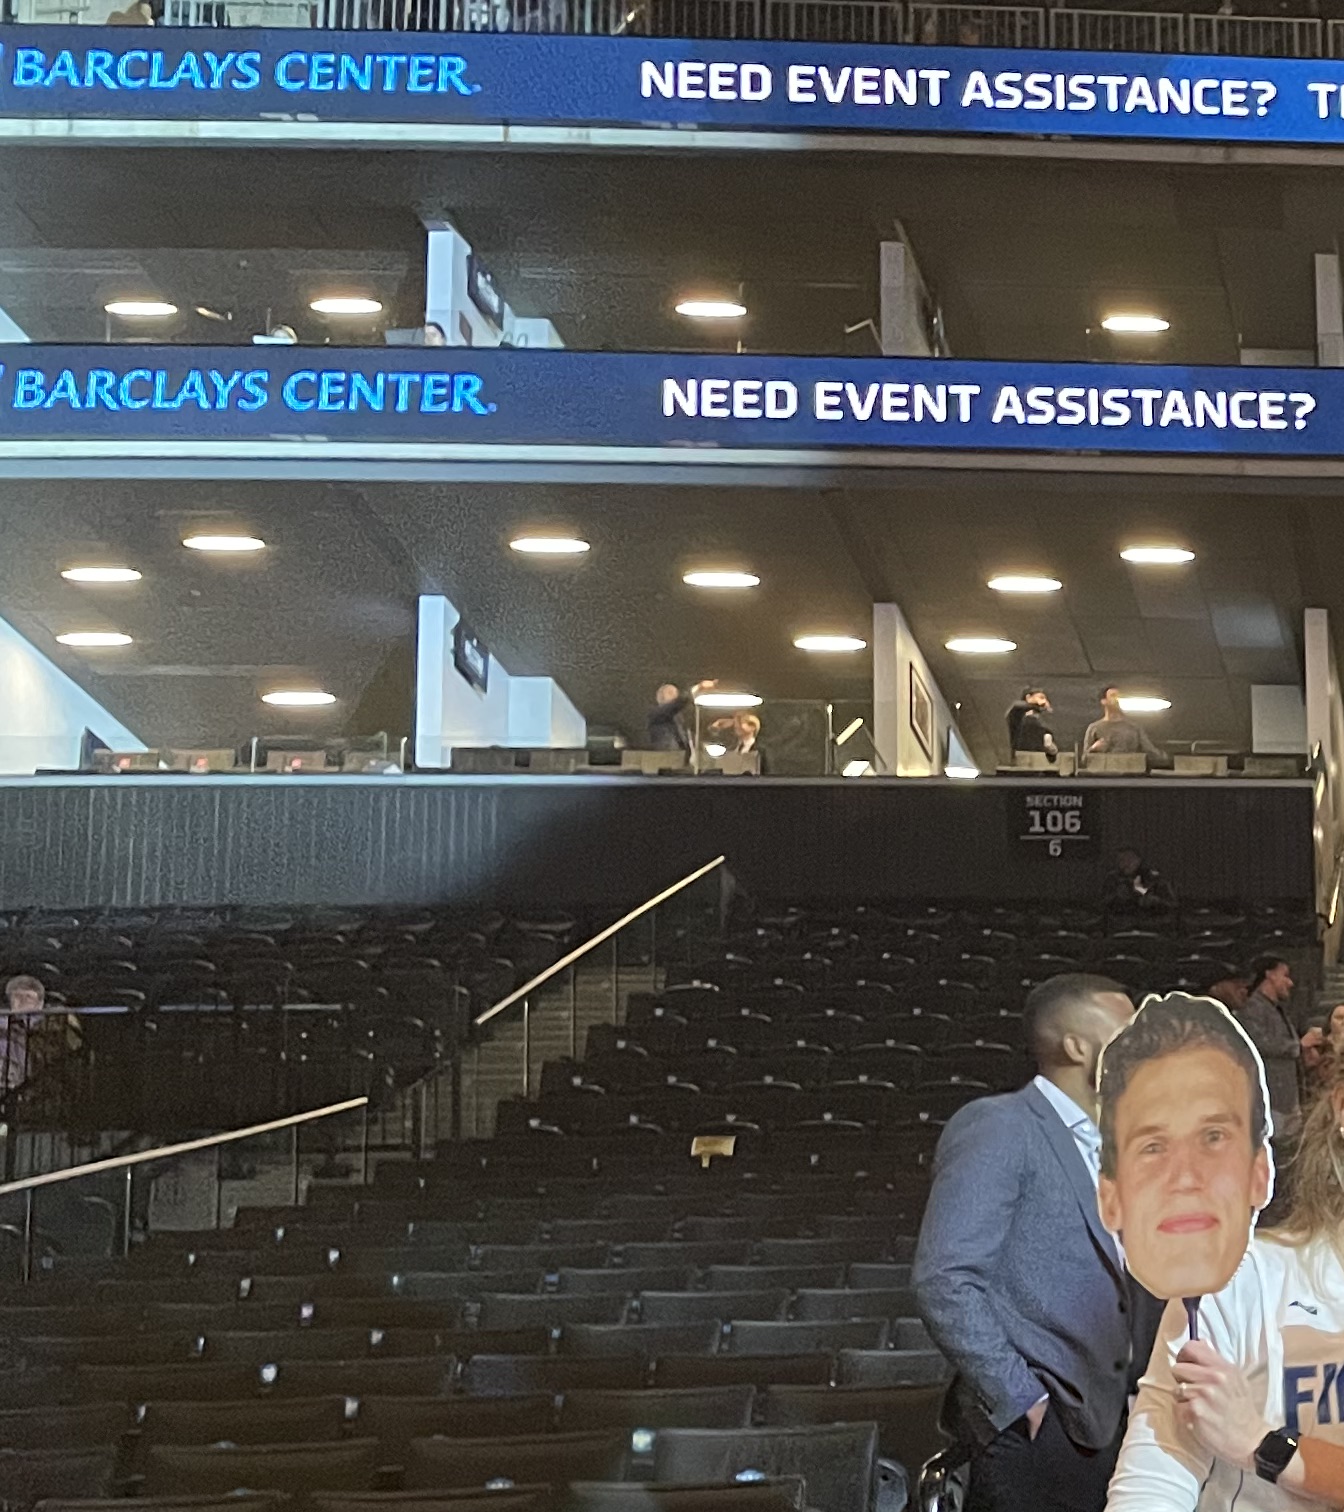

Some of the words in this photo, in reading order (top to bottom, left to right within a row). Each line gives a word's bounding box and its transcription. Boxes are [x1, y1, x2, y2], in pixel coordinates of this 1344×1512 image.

[13, 48, 261, 90] BARCLAYS
[641, 61, 771, 101] NEED
[787, 66, 950, 106] EVENT
[961, 71, 1276, 116] ASSISTANCE?
[13, 368, 270, 411] BARCLAYS
[663, 378, 797, 419] NEED
[814, 382, 980, 423] EVENT
[993, 386, 1317, 430] ASSISTANCE?
[1029, 810, 1081, 833] 106
[1049, 839, 1062, 857] 6
